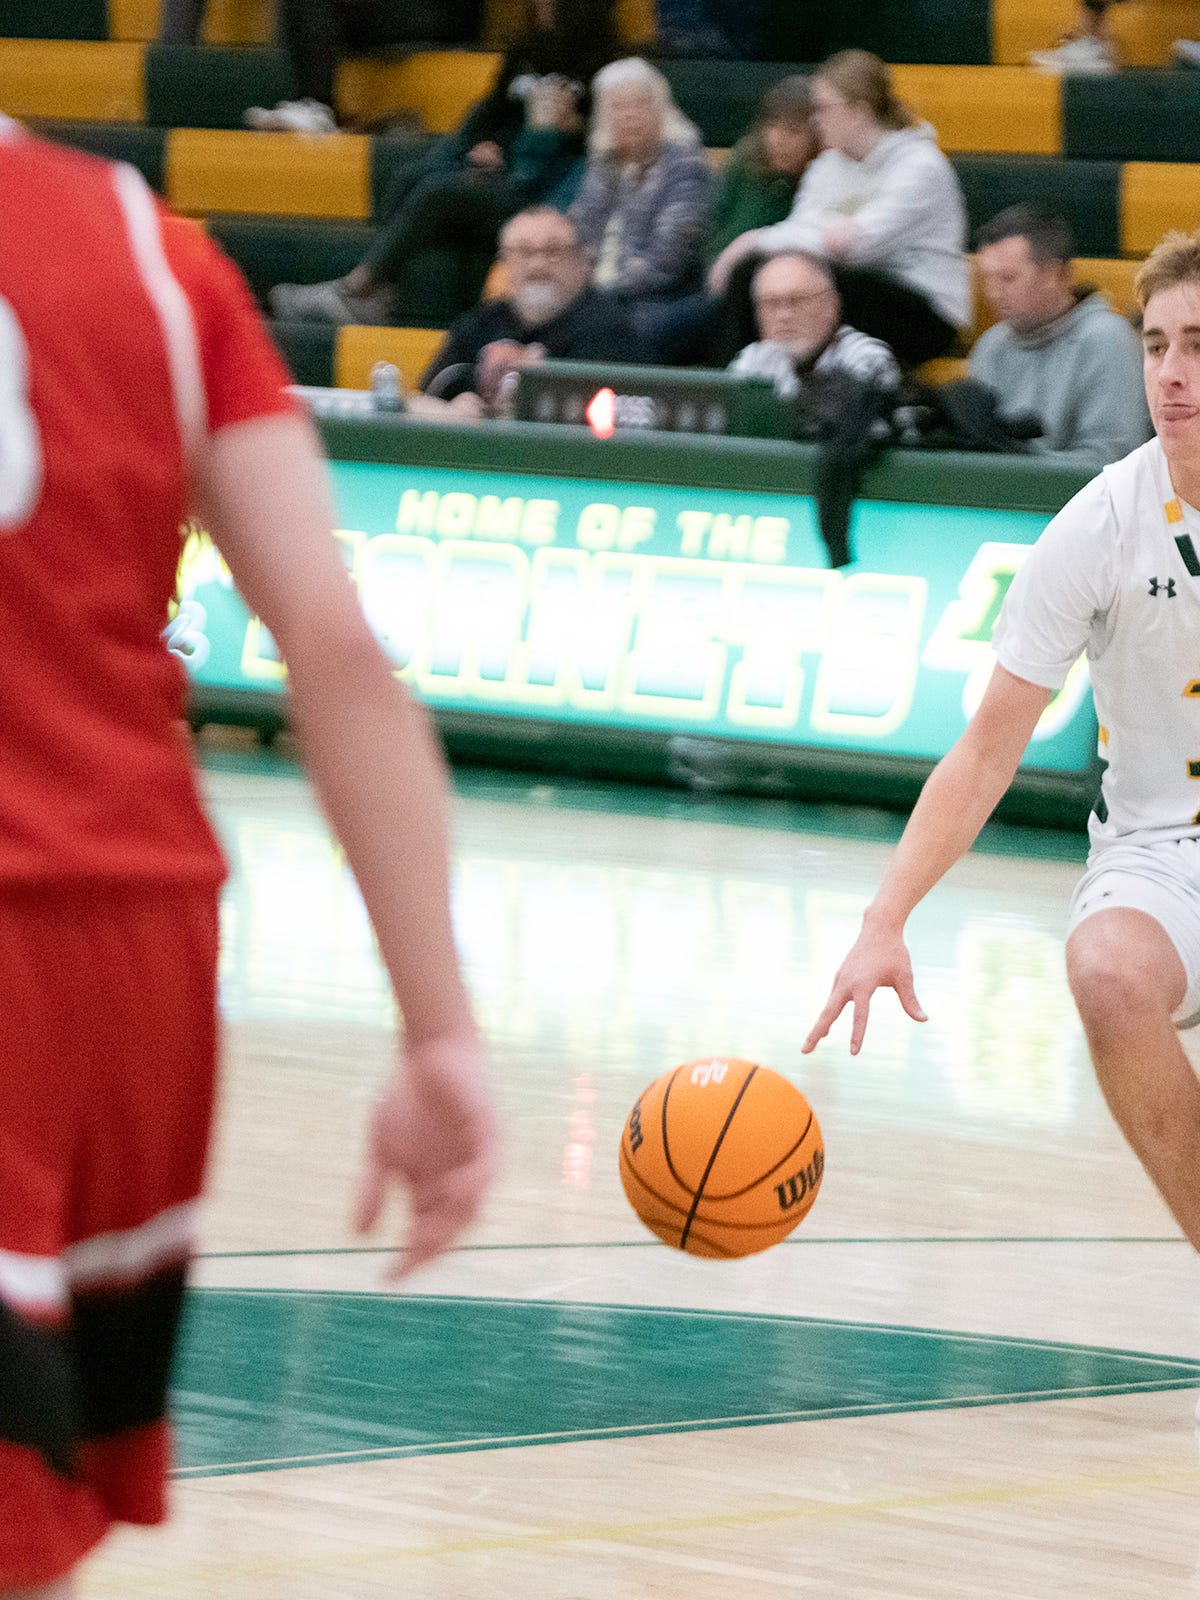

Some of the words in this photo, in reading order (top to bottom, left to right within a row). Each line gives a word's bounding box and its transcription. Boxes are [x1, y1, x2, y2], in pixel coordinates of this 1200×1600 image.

[397, 488, 561, 547] HOME
[577, 502, 658, 551] OF
[677, 508, 791, 563] THE
